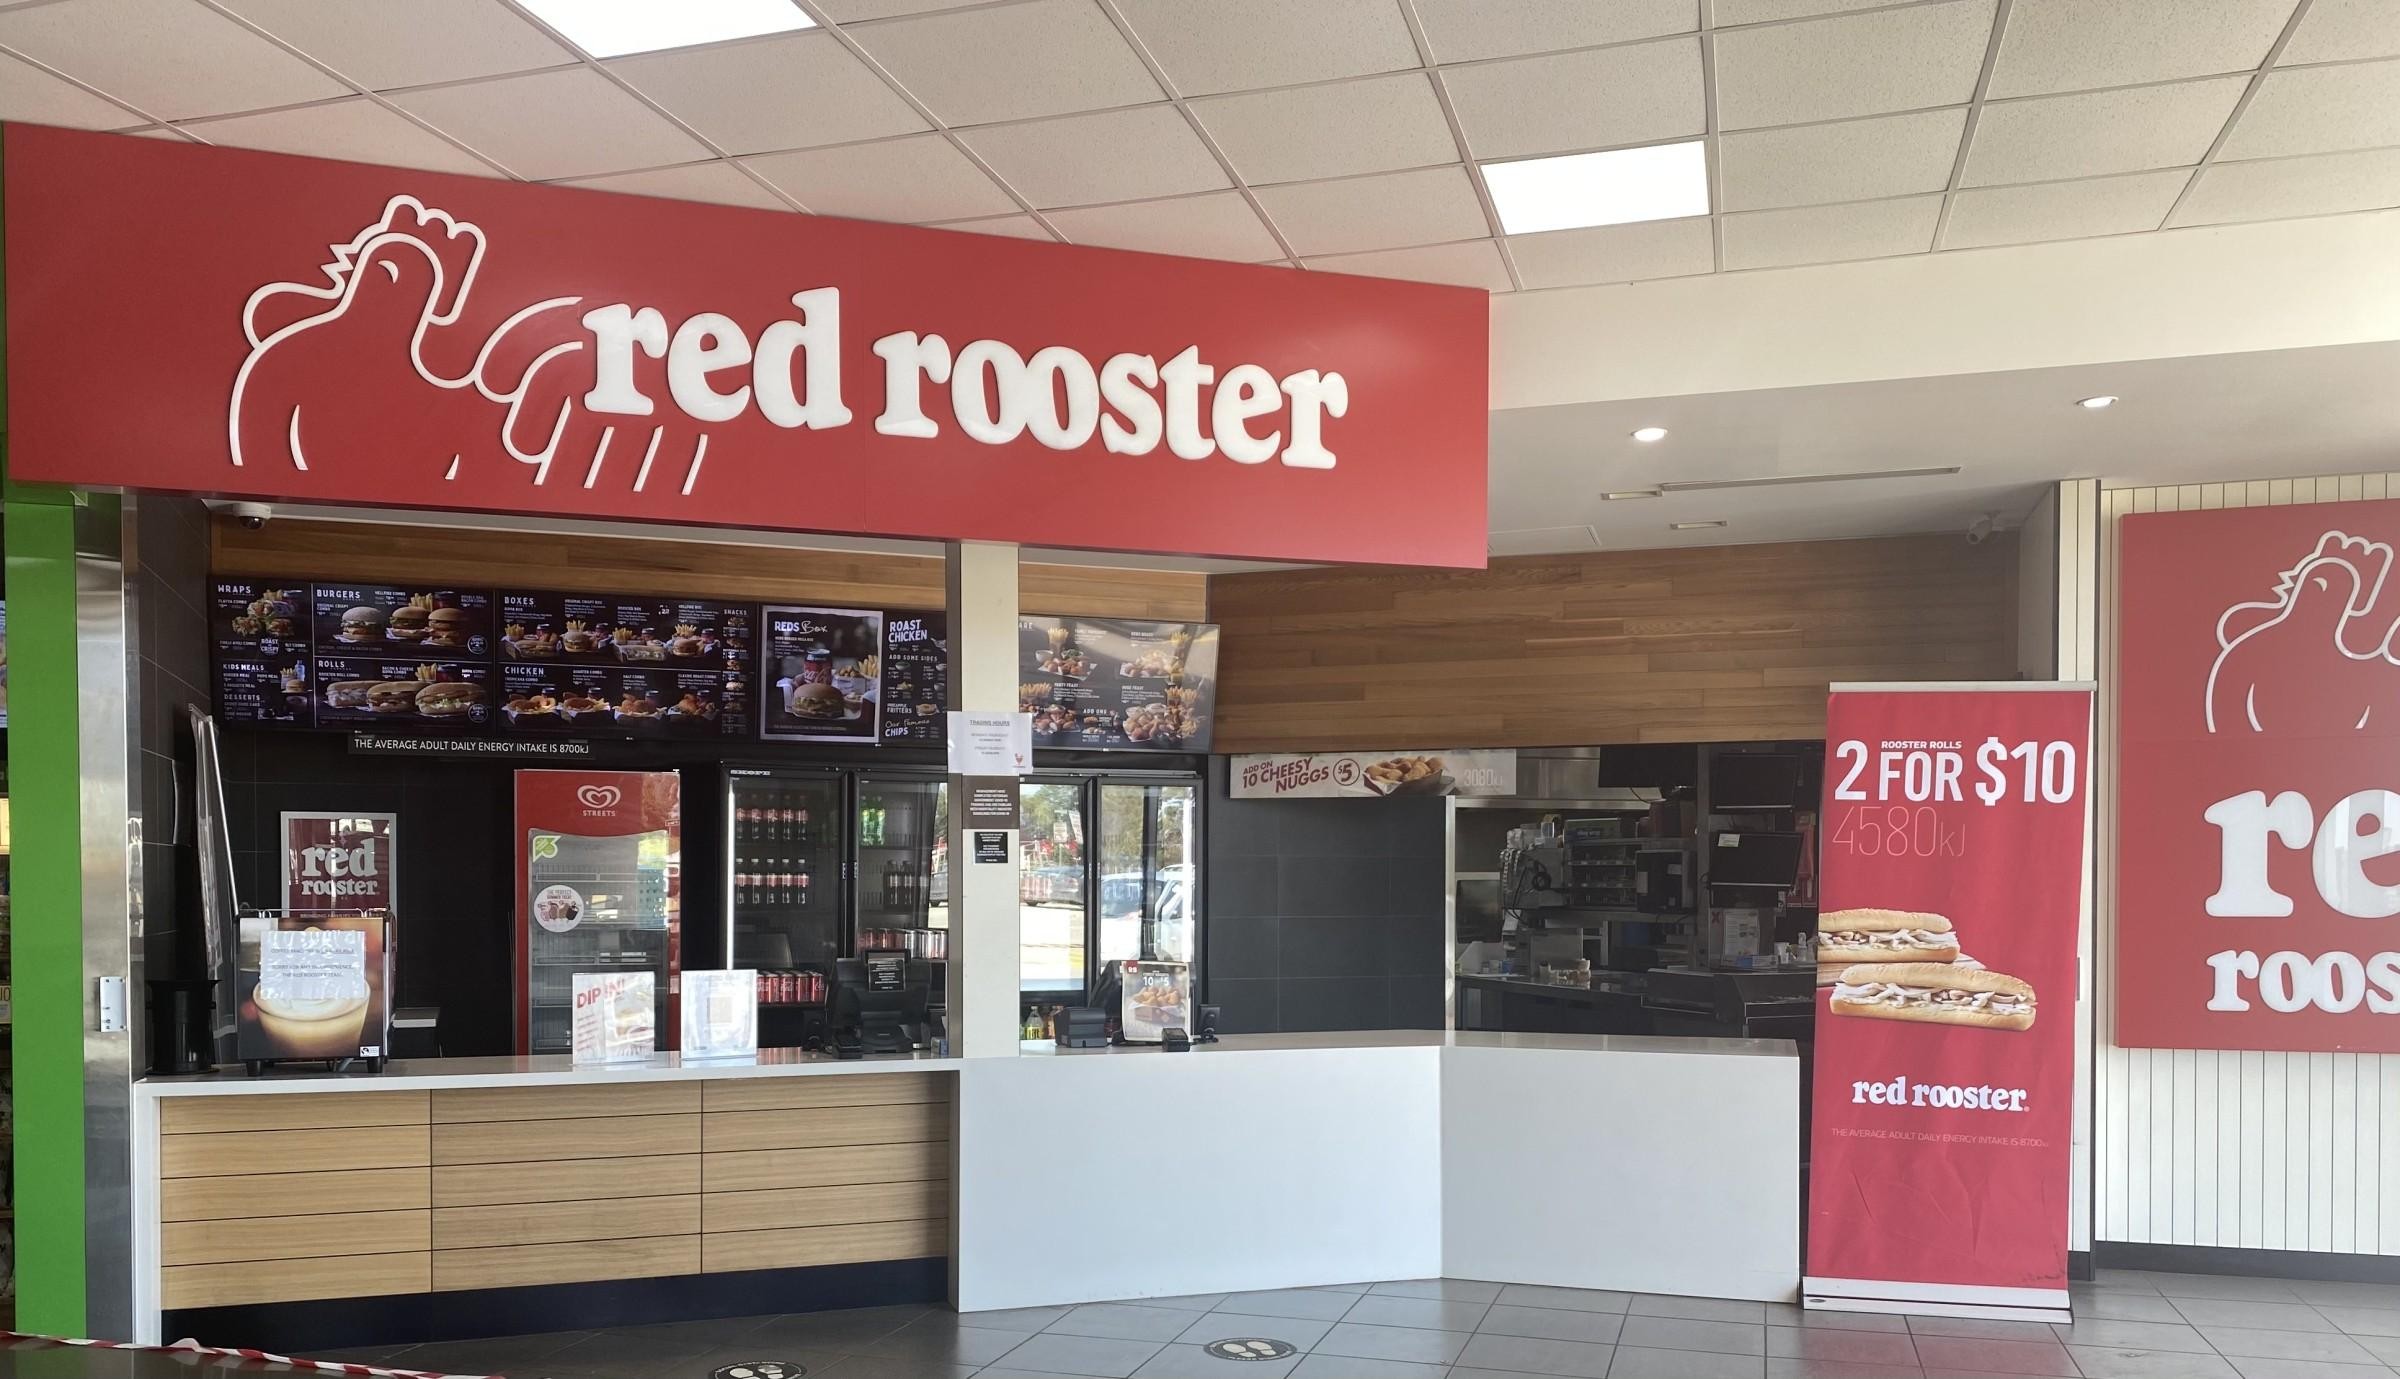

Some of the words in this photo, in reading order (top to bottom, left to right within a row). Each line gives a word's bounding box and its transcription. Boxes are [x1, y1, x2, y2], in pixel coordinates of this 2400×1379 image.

[582, 287, 853, 430] red
[873, 330, 1348, 469] rooster
[217, 584, 251, 594] WRAPS
[316, 589, 361, 599] BURGERS
[504, 596, 535, 605] BOXES
[774, 621, 800, 632] REDS
[800, 620, 827, 634] Box
[889, 619, 921, 632] ROAST
[888, 629, 928, 643] CHICKEN
[318, 660, 345, 668] ROLLS
[504, 666, 544, 675] CHICKEN
[885, 727, 908, 737] CHIPS
[354, 738, 373, 749] THE
[375, 739, 418, 750] AVERAGE
[419, 740, 449, 750] ADULT
[451, 741, 476, 752] DAILY
[478, 741, 514, 752] ENERGY
[516, 742, 548, 753] INTAKE
[550, 744, 557, 753] IS
[559, 744, 589, 754] 8700kJ
[1881, 741, 1927, 749] ROOSTER
[1929, 741, 1962, 749] ROLLS
[1243, 764, 1259, 775] ADD
[1259, 760, 1273, 770] ON
[1243, 774, 1258, 789] 10
[1260, 756, 1313, 783] CHEESY
[1337, 763, 1353, 783] $5
[1834, 739, 1868, 801] 2
[1878, 750, 1964, 802] FOR
[1975, 736, 2076, 806] $10
[1275, 766, 1330, 793] NUGGS
[1831, 805, 1966, 857] 4580kJ
[301, 838, 378, 877] red
[2204, 789, 2400, 918] re
[301, 879, 378, 896] rooster
[1143, 976, 1154, 986] 10
[2206, 949, 2400, 1015] roos
[577, 987, 601, 1008] DIP
[1852, 1076, 1908, 1105] red
[1831, 1127, 1848, 1137] THE
[1848, 1128, 1887, 1139] AVERAGE
[1889, 1131, 1917, 1141] ADULT
[1918, 1132, 1942, 1142] DAILY
[1942, 1134, 1977, 1145] ENERGY
[1978, 1136, 2009, 1146] INTAKE
